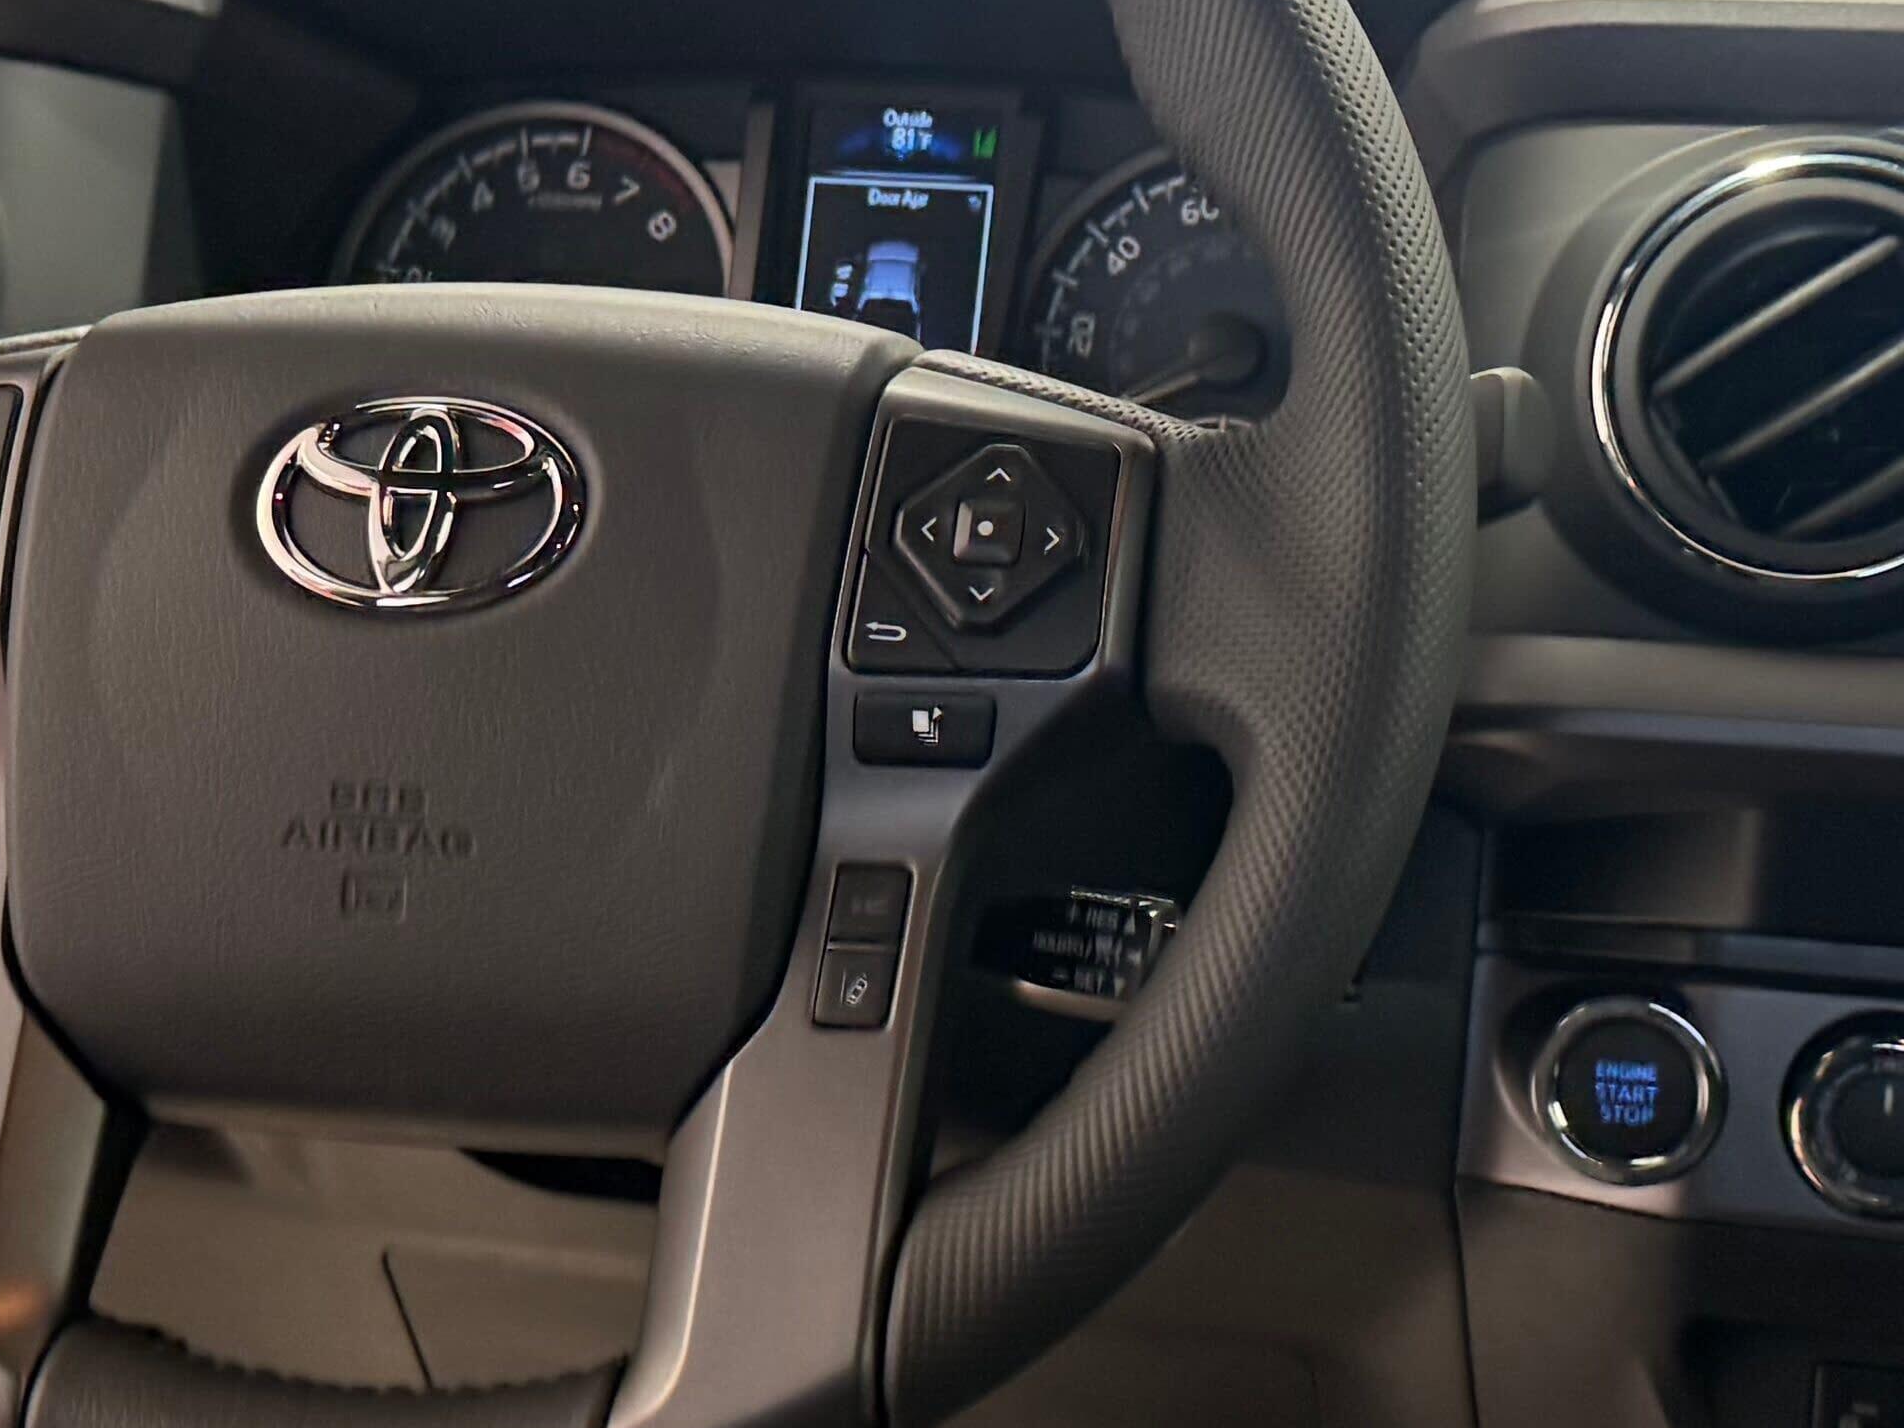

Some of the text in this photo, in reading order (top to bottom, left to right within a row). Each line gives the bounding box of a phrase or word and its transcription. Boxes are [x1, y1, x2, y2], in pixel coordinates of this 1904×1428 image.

[567, 161, 591, 189] 6
[647, 210, 676, 241] 8
[1107, 236, 1141, 276] 40
[1595, 1060, 1657, 1083] ENGINE
[1594, 1082, 1658, 1103] START
[1599, 1102, 1655, 1126] STOP
